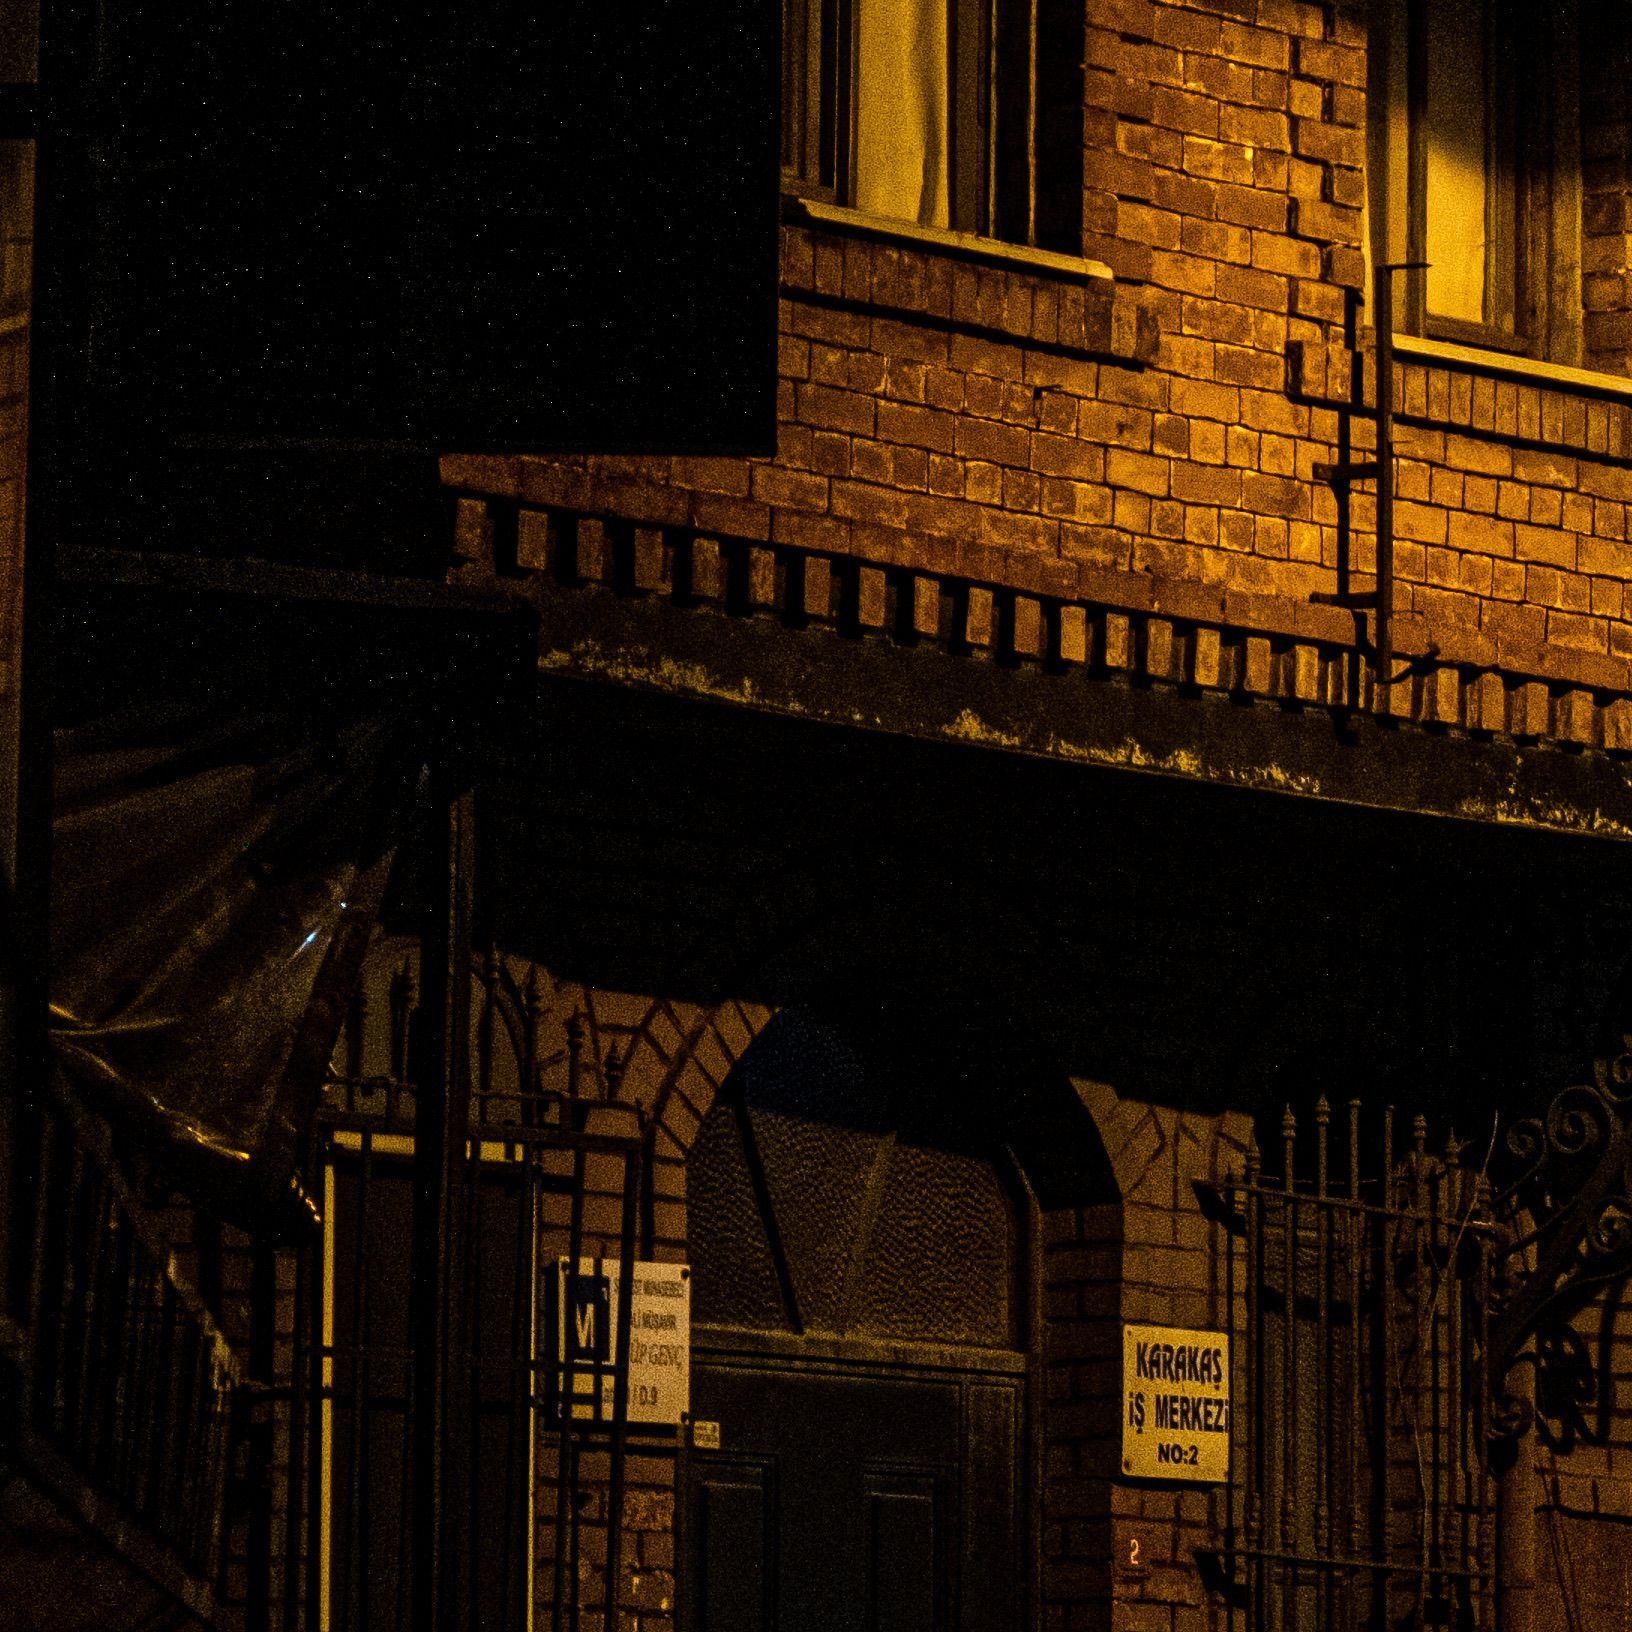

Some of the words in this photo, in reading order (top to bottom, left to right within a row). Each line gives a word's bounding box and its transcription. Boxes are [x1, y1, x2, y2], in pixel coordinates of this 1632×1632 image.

[1137, 1342, 1222, 1390] KARAKAŞ
[1129, 1392, 1145, 1434] İŞ
[1155, 1394, 1229, 1433] MERKEZİ
[1158, 1443, 1198, 1465] NO:2
[1130, 1538, 1139, 1565] 2
